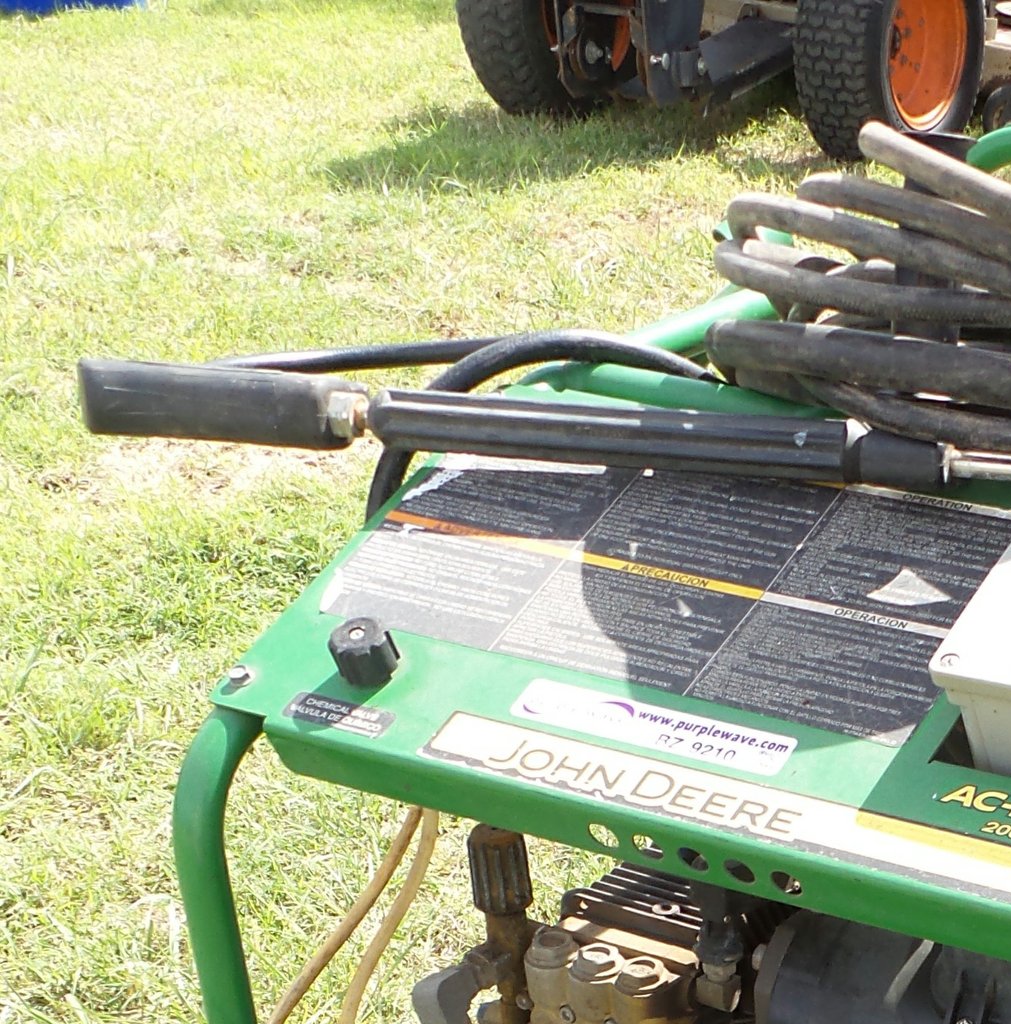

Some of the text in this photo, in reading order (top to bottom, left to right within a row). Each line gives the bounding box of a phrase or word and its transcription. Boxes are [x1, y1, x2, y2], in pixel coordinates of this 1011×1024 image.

[902, 493, 973, 511] OPERATION
[631, 565, 709, 588] PRECAUCION
[834, 608, 908, 629] OPERACION
[305, 698, 350, 715] CHEMICAL
[638, 711, 789, 754] www.purplewave.com
[690, 742, 736, 760] 9210
[488, 738, 802, 835] JOHN DEERE
